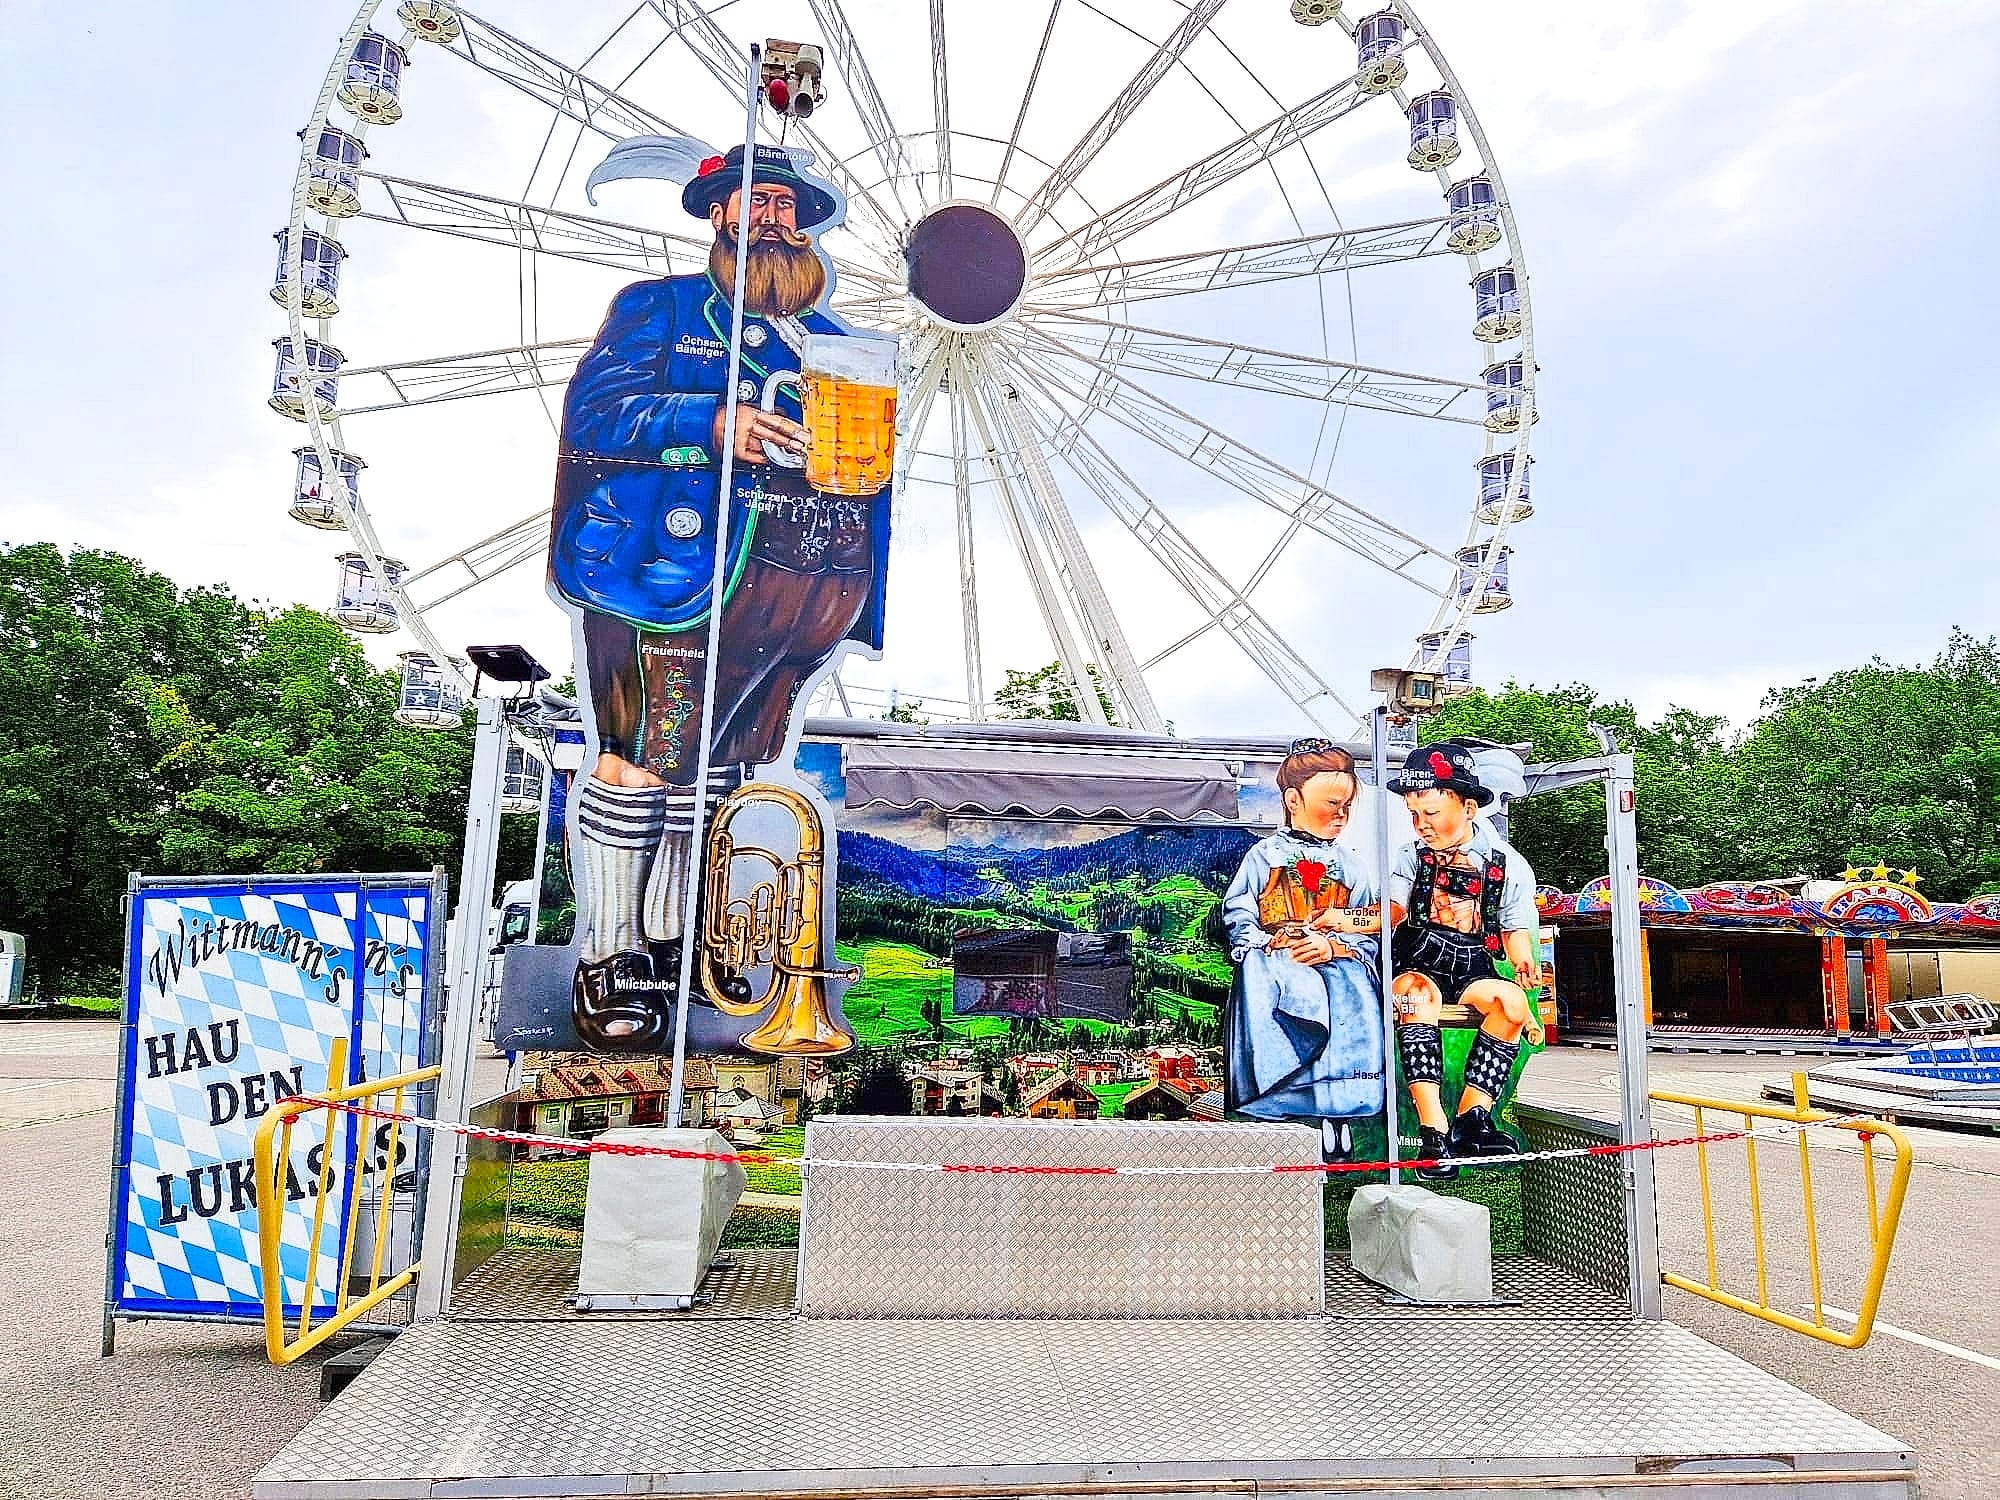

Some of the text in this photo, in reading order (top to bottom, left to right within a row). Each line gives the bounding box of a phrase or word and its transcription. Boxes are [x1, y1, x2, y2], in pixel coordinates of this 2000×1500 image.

[675, 343, 725, 358] Bändiger
[641, 644, 705, 659] Frauenheld
[1401, 768, 1435, 779] Bären-
[1399, 777, 1435, 788] Fänger
[1343, 908, 1380, 917] Großer
[1352, 917, 1371, 927] Bär
[614, 977, 677, 991] Milchbube
[144, 1019, 239, 1078] HAU
[1353, 1069, 1381, 1080] Hase
[206, 1065, 303, 1127] DEN
[1397, 1135, 1424, 1147] Maus
